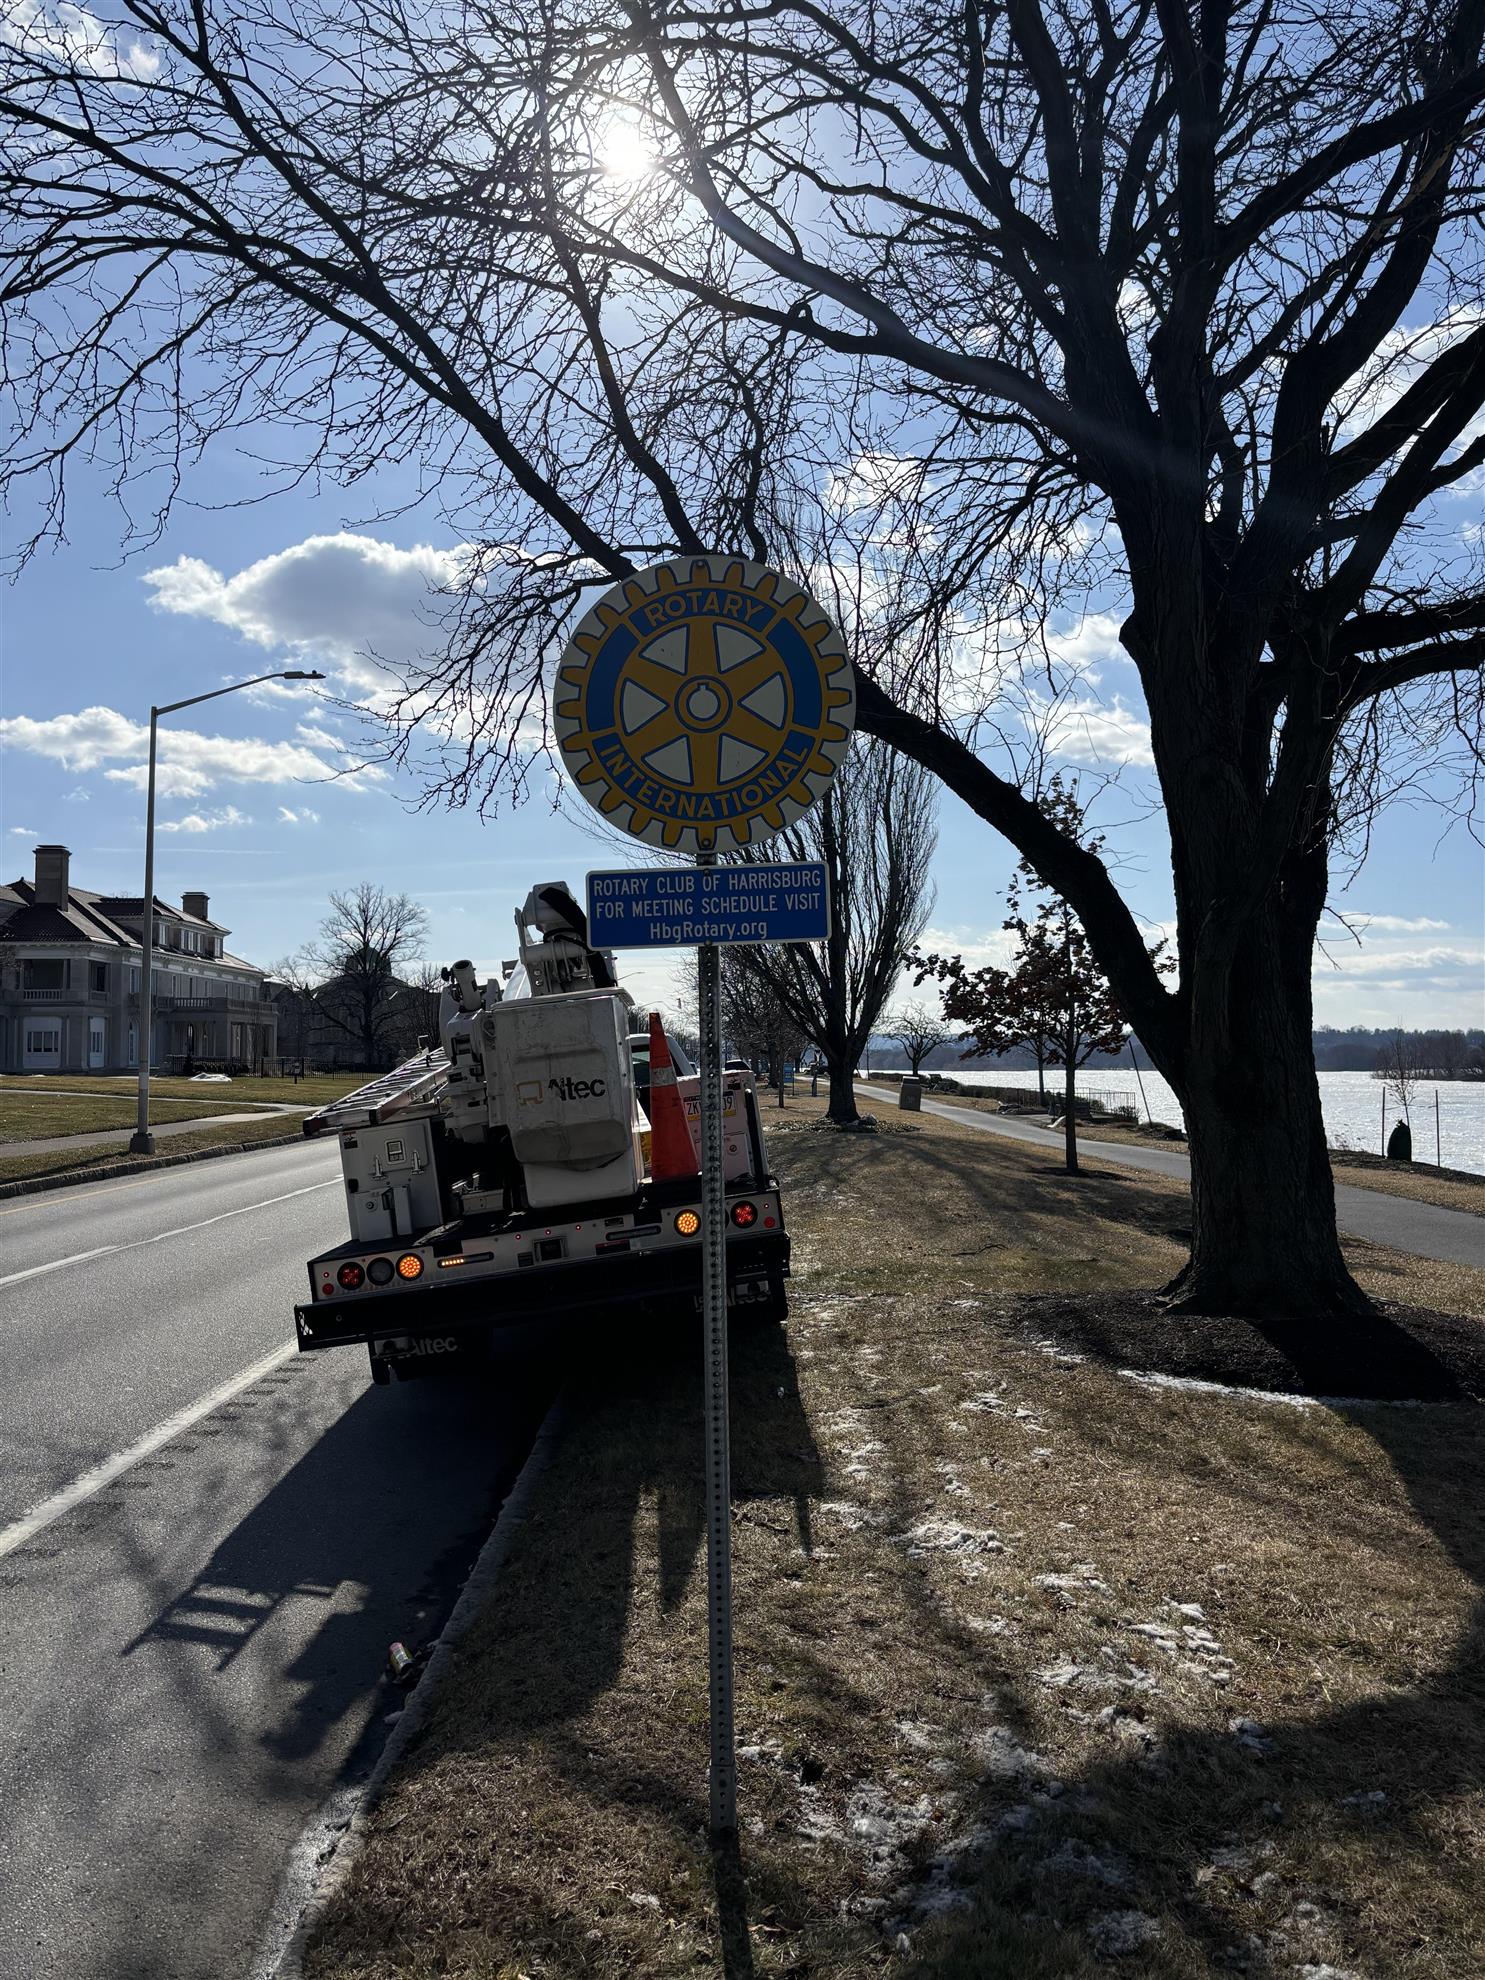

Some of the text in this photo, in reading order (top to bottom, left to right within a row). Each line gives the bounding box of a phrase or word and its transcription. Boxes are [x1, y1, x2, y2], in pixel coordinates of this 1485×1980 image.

[646, 590, 764, 628] ROTARY
[601, 744, 808, 818] INTERNATIONAL
[593, 870, 821, 896] ROTARY CLUB OF HARRISBURG
[596, 892, 820, 919] FOR MEETING SCHEDULE VISIT
[650, 921, 767, 943] HbgRotary.org
